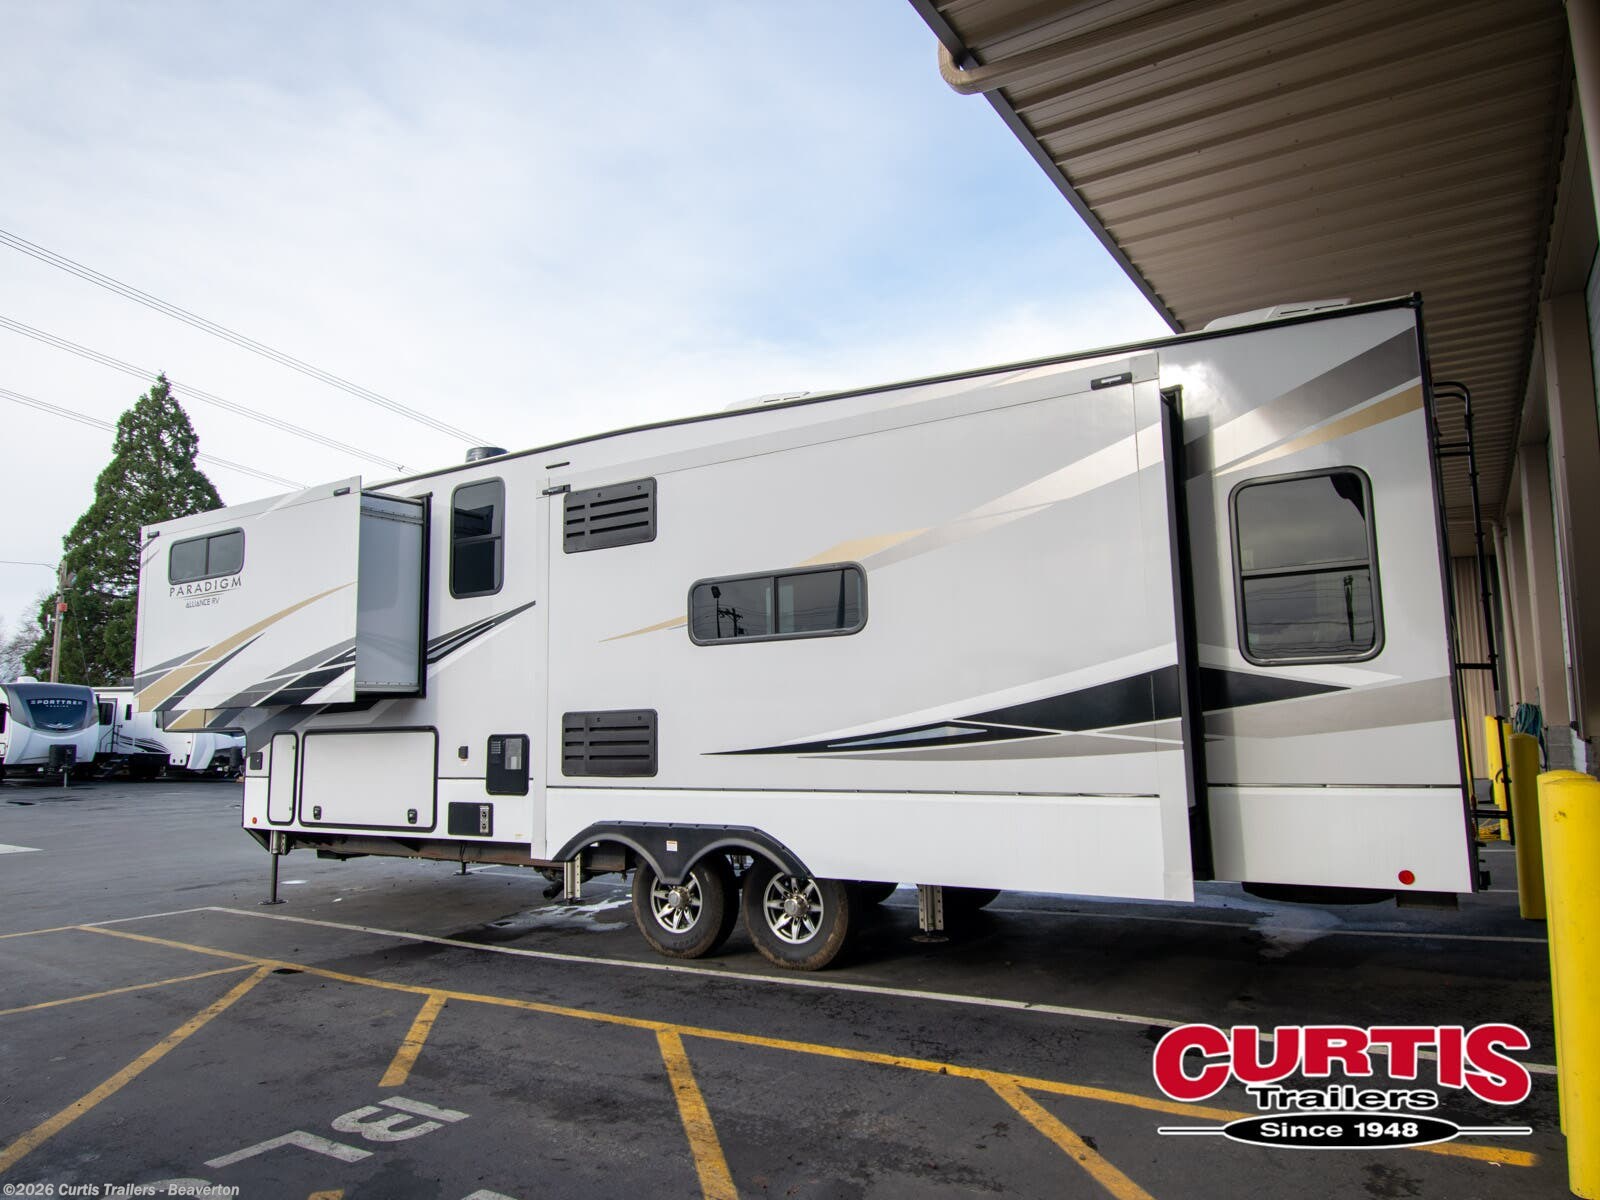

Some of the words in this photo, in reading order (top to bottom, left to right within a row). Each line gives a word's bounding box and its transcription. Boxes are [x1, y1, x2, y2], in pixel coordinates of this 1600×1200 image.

[169, 576, 241, 597] PARADIGM
[185, 598, 210, 608] ALLIANCE
[211, 596, 220, 605] RV
